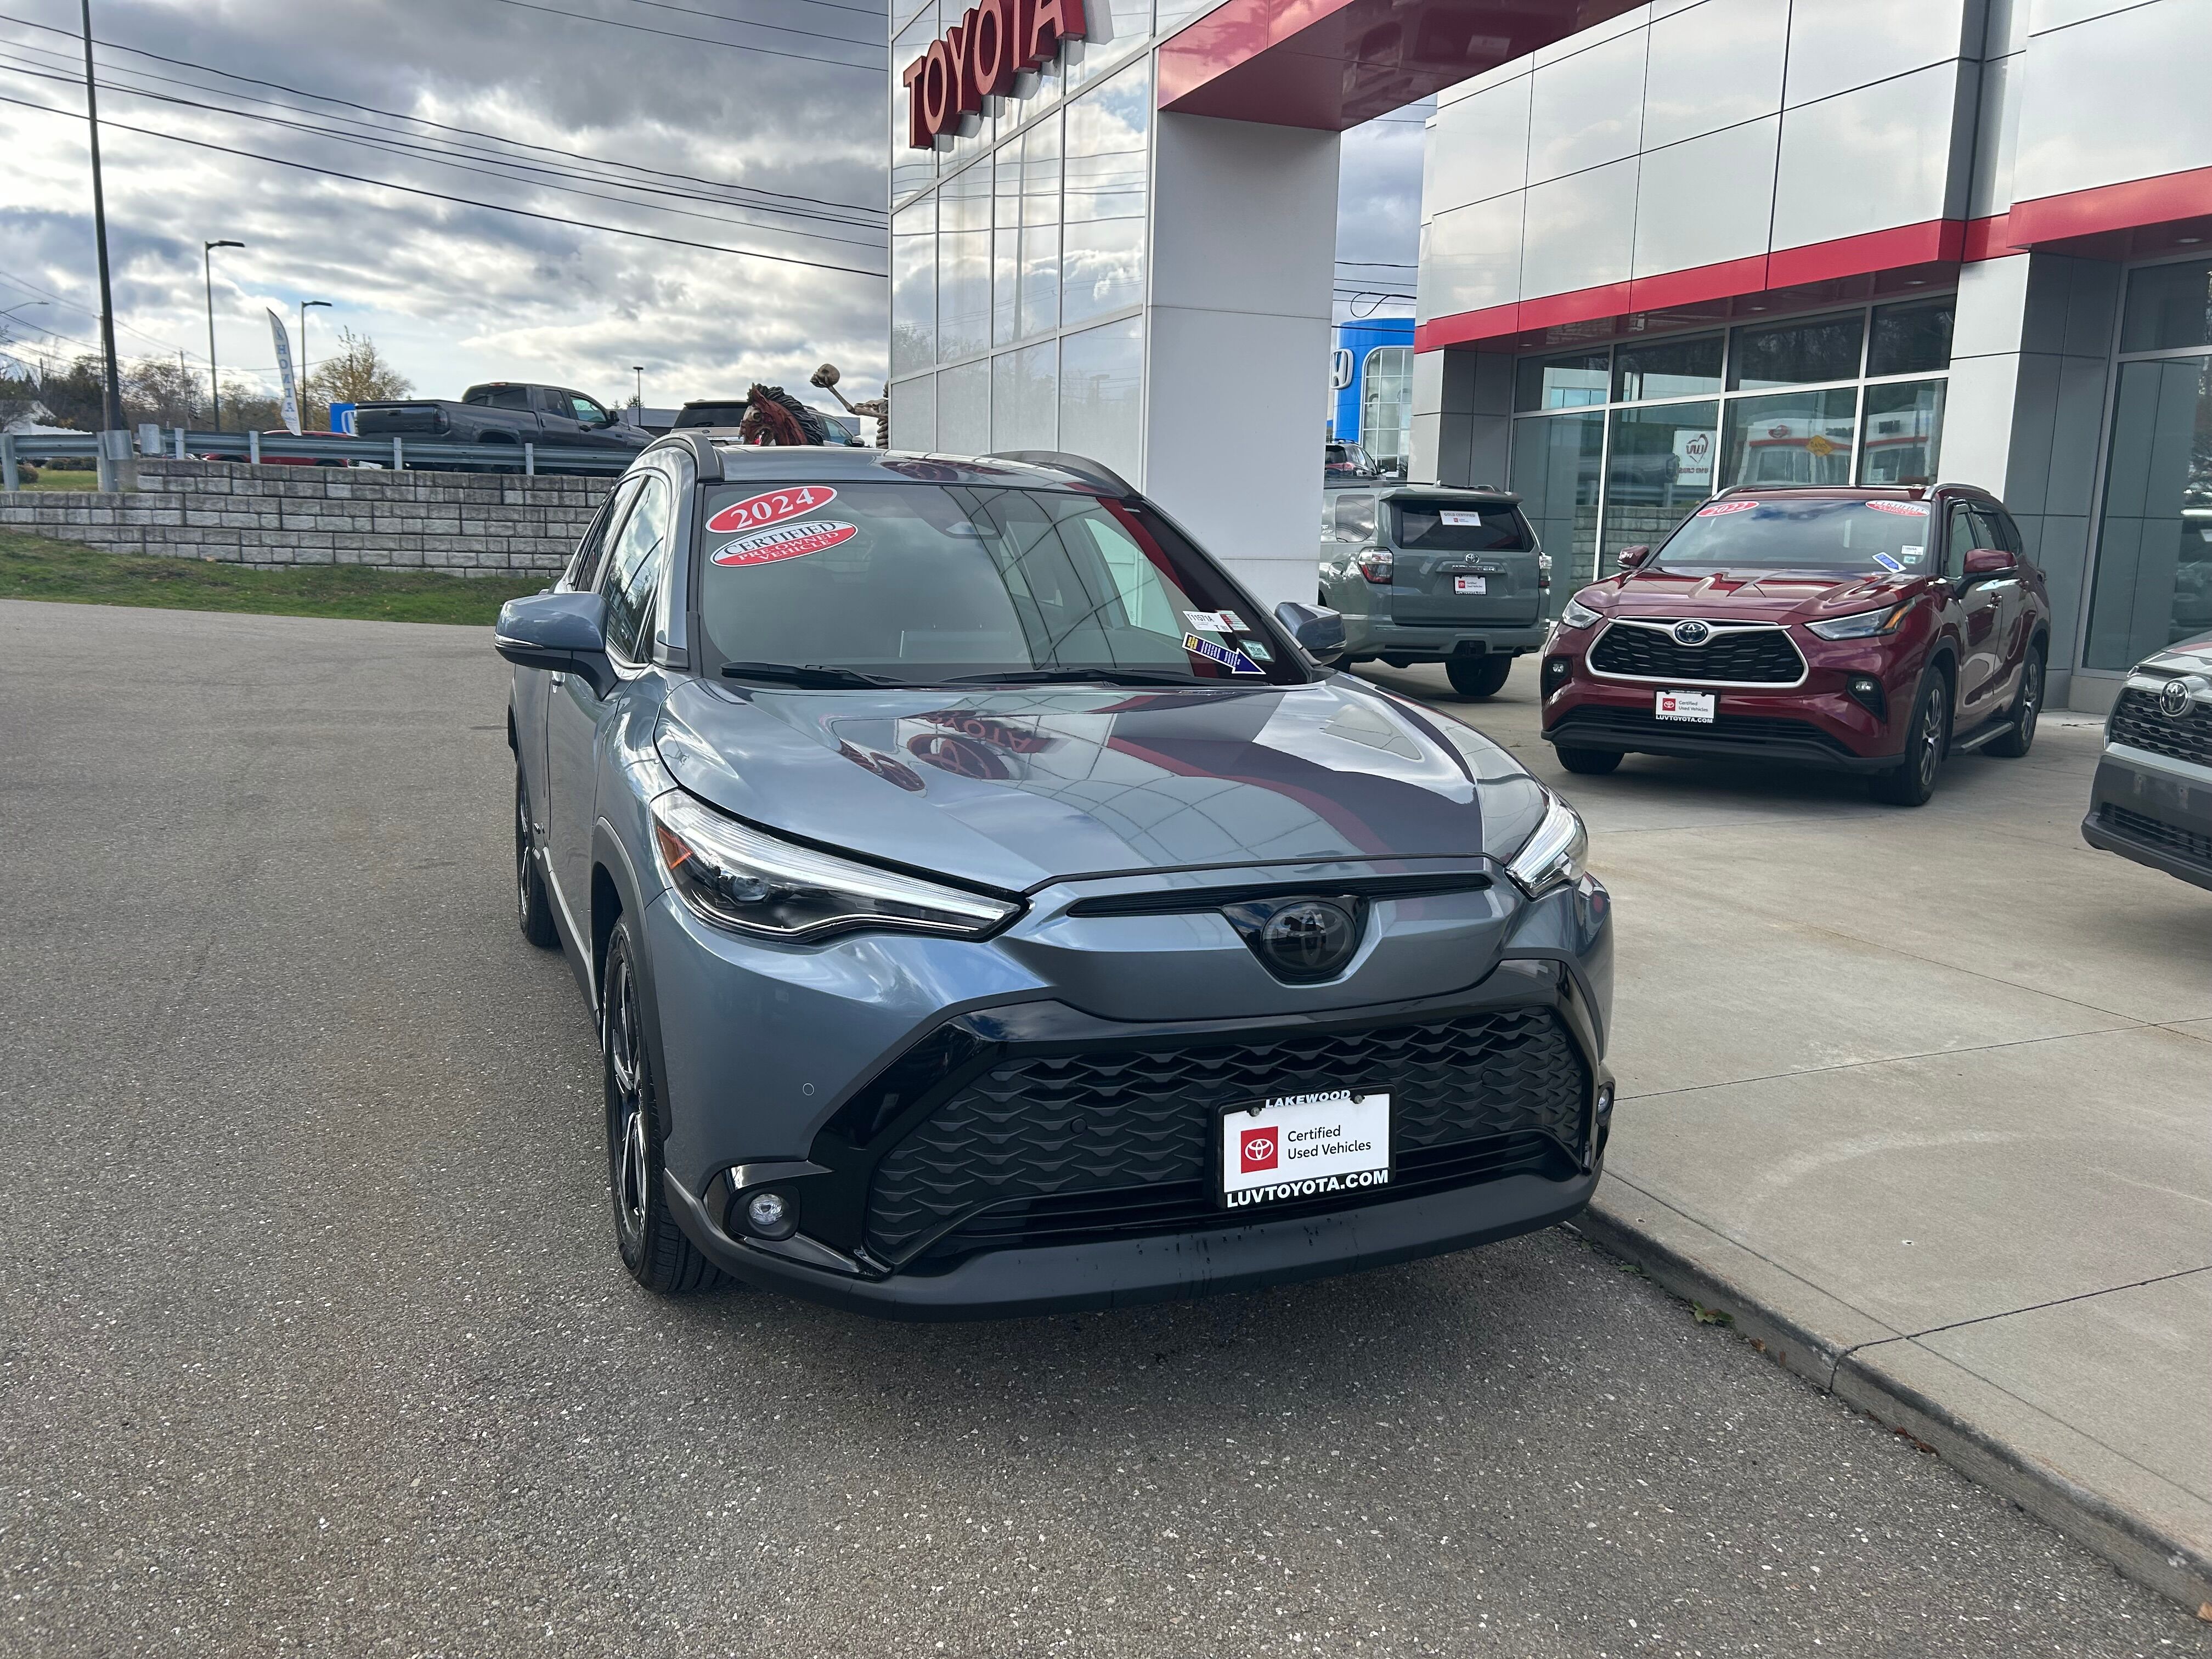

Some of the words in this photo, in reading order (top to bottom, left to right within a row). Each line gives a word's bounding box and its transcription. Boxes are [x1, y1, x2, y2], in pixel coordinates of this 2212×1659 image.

[730, 488, 815, 529] 2024
[724, 522, 837, 555] CERTIFIED
[737, 532, 839, 561] PRE-OWNED
[761, 539, 832, 560] VEHICLE
[1656, 715, 1713, 724] LUVTOYOTA.COM
[1265, 1090, 1351, 1109] LAKEWOOD
[1288, 1125, 1341, 1142] Certified
[1288, 1144, 1318, 1160] Used
[1322, 1140, 1372, 1155] Vehicles
[1227, 1169, 1388, 1207] LUVTOYOTA.COM
